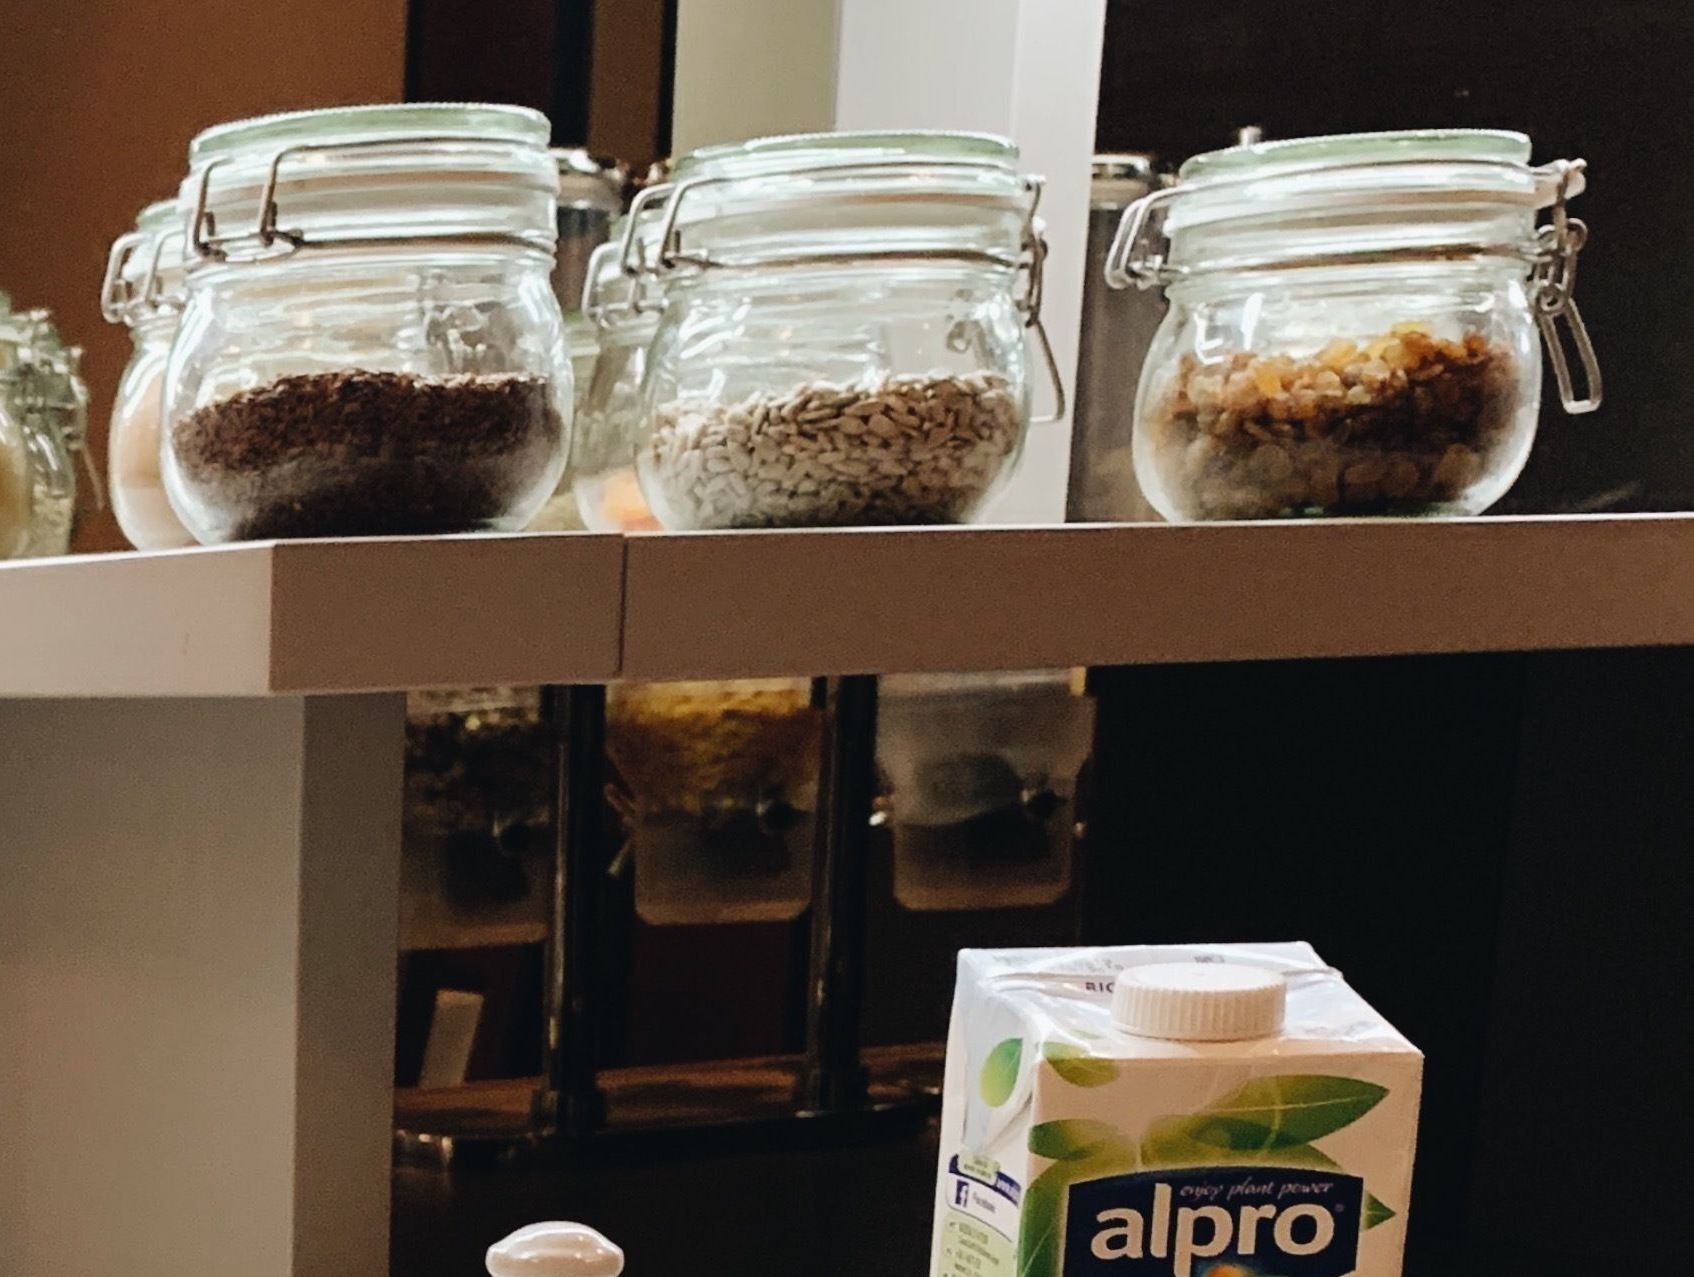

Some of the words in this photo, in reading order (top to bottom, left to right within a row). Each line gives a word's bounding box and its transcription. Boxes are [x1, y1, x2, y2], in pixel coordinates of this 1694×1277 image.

[1085, 981, 1115, 993] RIC
[1179, 1184, 1223, 1201] enjoy
[1226, 1176, 1275, 1201] plant
[1277, 1181, 1334, 1200] power
